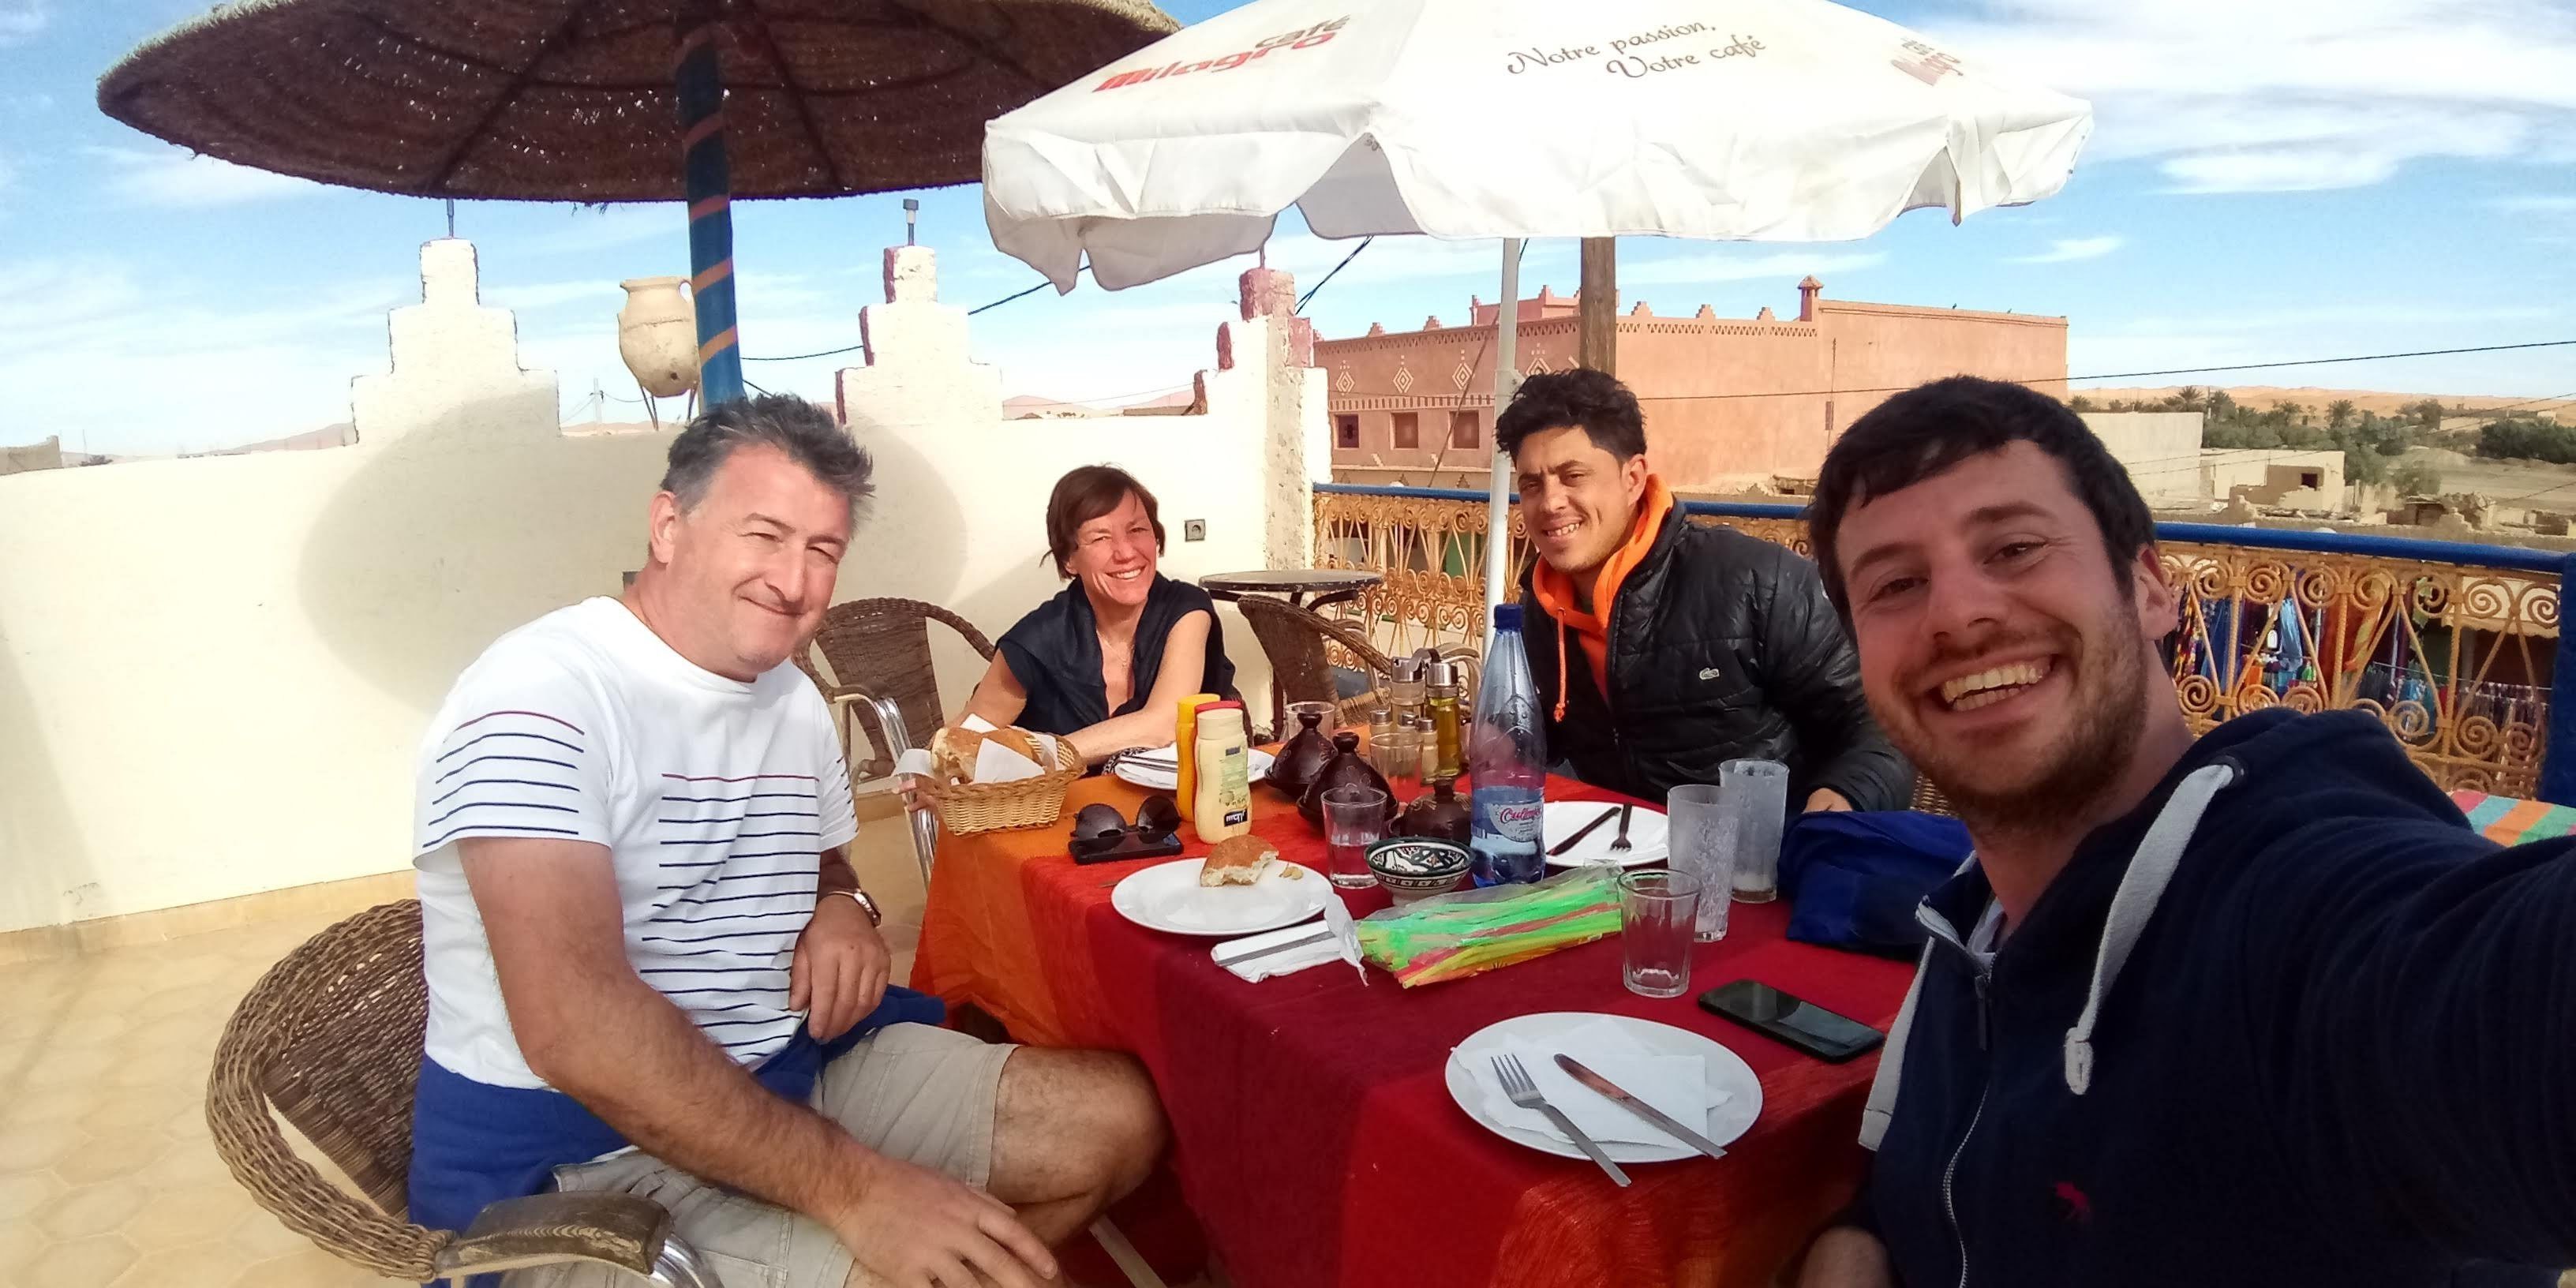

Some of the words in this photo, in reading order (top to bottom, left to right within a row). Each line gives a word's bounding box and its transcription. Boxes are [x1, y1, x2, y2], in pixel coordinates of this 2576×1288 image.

[1507, 47, 1601, 74] Notre
[1606, 55, 1701, 78] Votre
[1709, 34, 1766, 58] café
